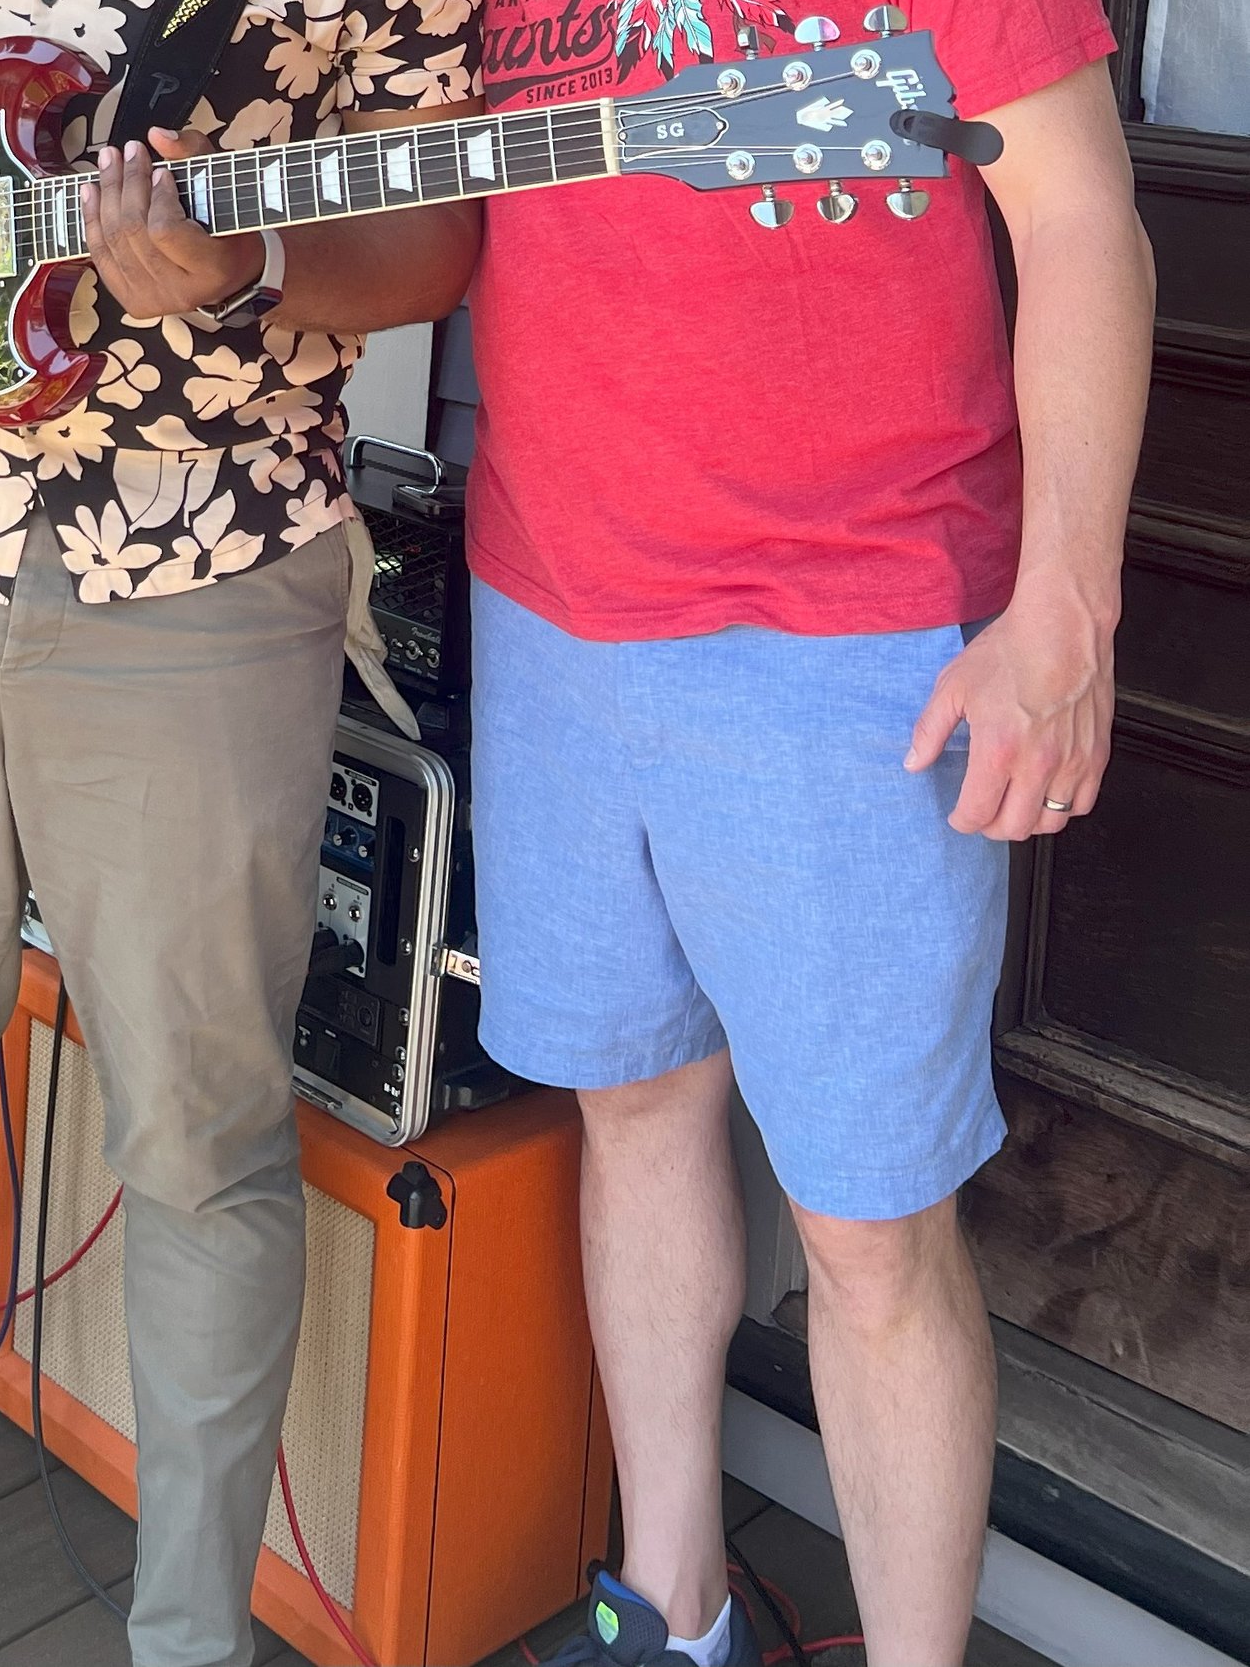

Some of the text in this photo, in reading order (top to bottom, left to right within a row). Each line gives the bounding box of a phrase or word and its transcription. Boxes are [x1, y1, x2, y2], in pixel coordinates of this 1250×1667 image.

[526, 67, 613, 104] SINCE 2013
[656, 122, 685, 140] SG
